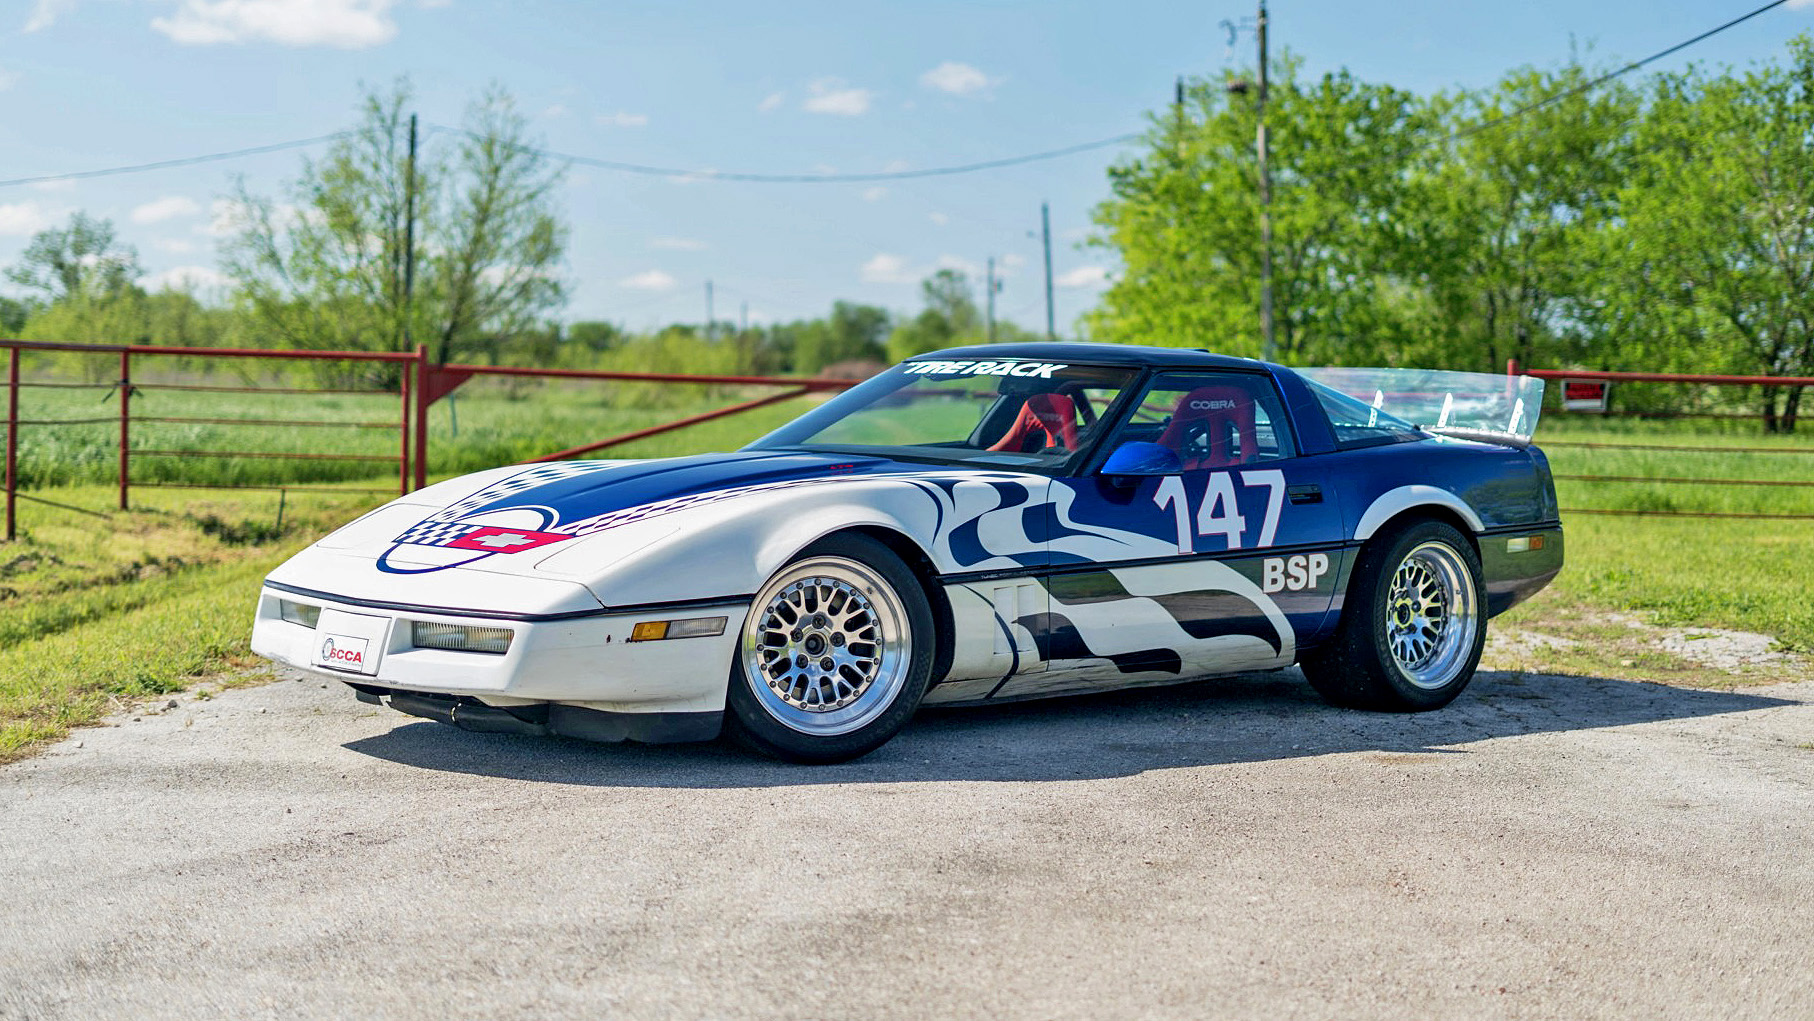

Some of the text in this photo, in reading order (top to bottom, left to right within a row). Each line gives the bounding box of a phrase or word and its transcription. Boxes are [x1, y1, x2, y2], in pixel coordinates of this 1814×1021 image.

[1190, 400, 1236, 410] COBRA
[1153, 469, 1286, 555] 147
[1262, 553, 1329, 594] BSP
[330, 648, 362, 663] SCCA
